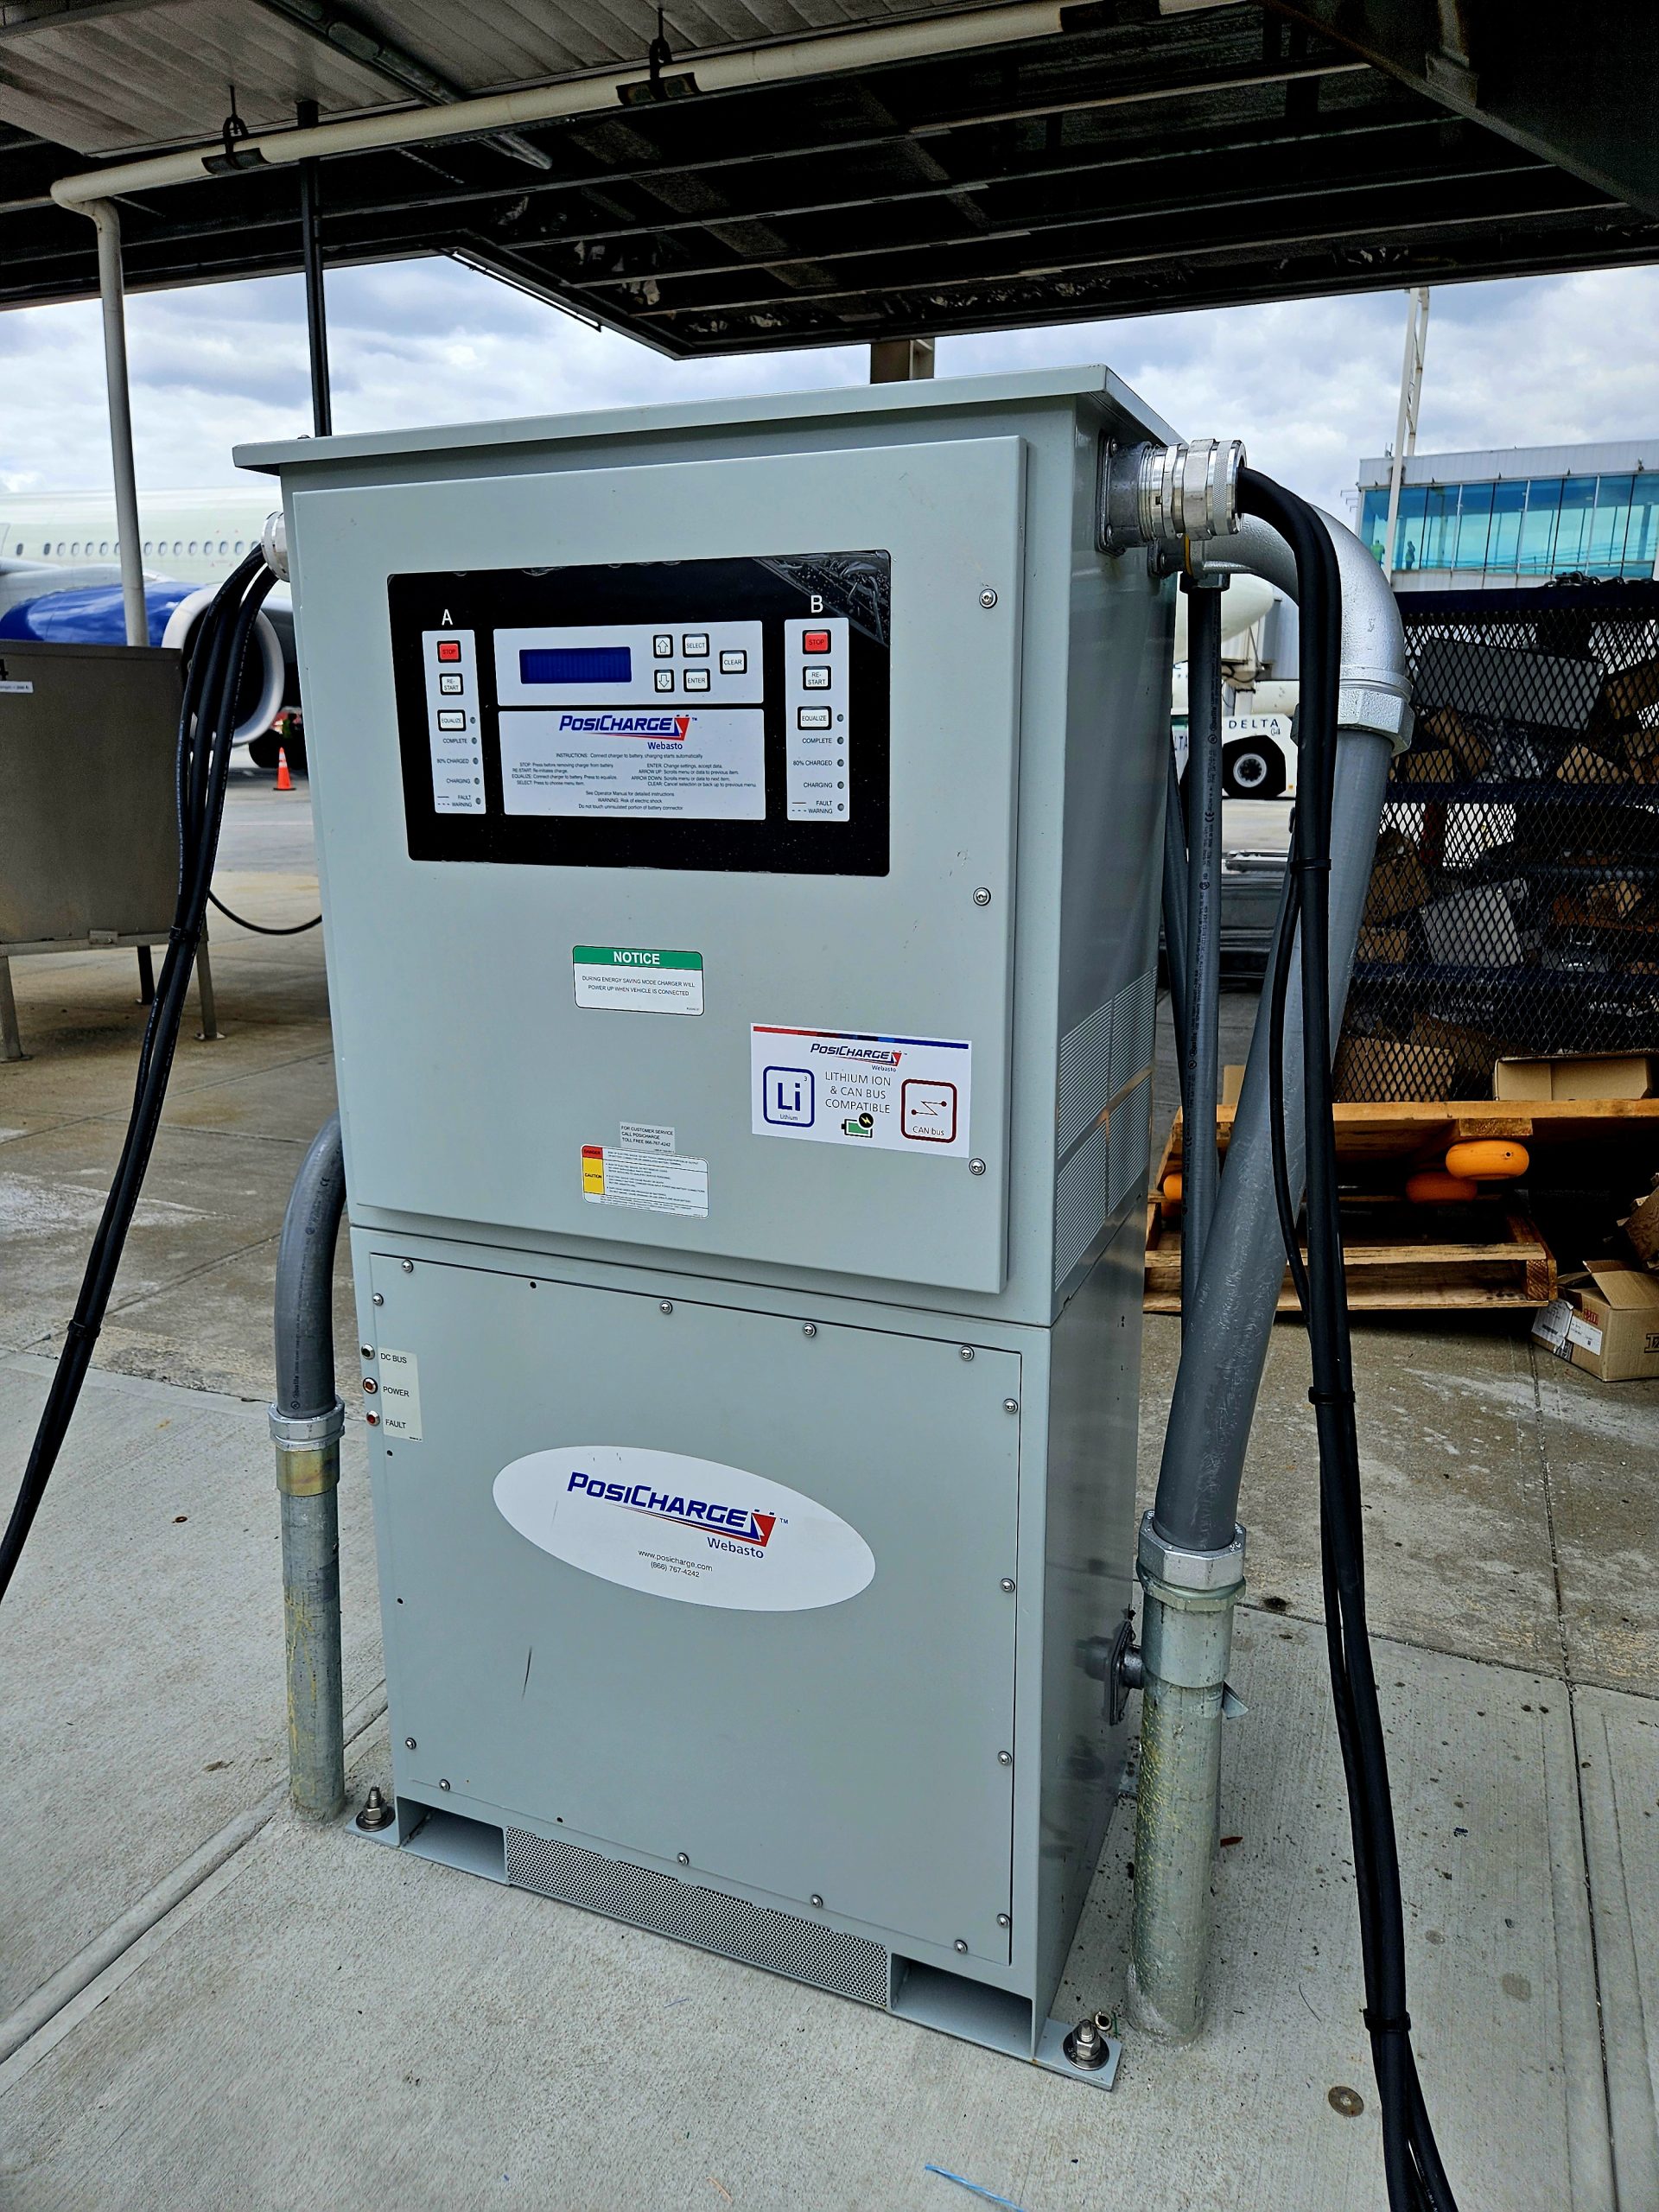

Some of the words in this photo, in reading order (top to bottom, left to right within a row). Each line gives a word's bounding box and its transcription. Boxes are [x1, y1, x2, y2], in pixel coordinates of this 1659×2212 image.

[810, 594, 823, 613] B
[442, 609, 453, 626] A
[1229, 719, 1280, 728] DELTA
[613, 951, 660, 964] NOTICE
[825, 1071, 868, 1084] LITHIUM
[872, 1075, 891, 1086] ION
[777, 1082, 801, 1111] Li
[841, 1087, 862, 1097] CAN
[866, 1089, 886, 1099] BUS
[825, 1098, 890, 1114] COMPATIBLE
[912, 1126, 930, 1135] CAN
[931, 1127, 944, 1136] bus
[392, 1355, 407, 1363] BUS
[383, 1386, 410, 1397] POWER
[385, 1419, 406, 1428] FAULT
[707, 1536, 764, 1559] Webasto
[639, 1550, 713, 1572] www.posicharge.com
[651, 1561, 667, 1572] (866)
[669, 1565, 700, 1578] 767-4242
